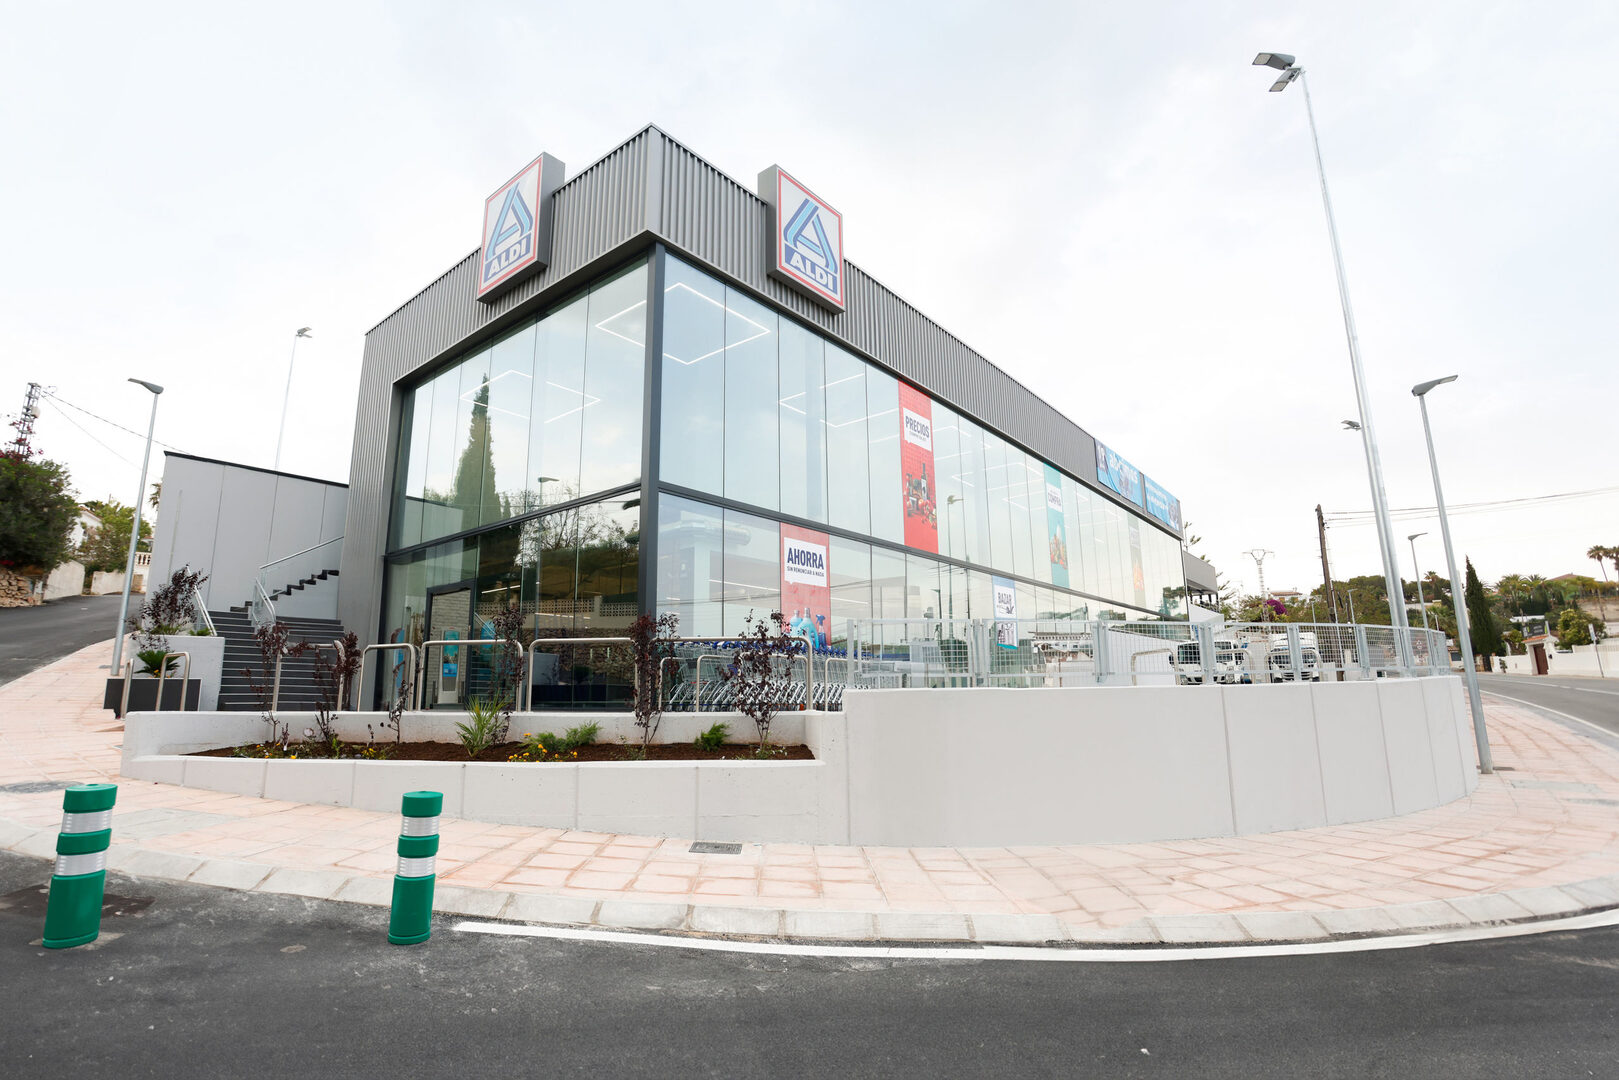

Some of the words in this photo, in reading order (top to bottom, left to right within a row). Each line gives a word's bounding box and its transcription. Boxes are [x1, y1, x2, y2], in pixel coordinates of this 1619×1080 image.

[487, 238, 527, 280] ALDI
[790, 251, 834, 291] ALDI
[905, 415, 930, 438] PRECIOS
[787, 547, 824, 570] AHORRA
